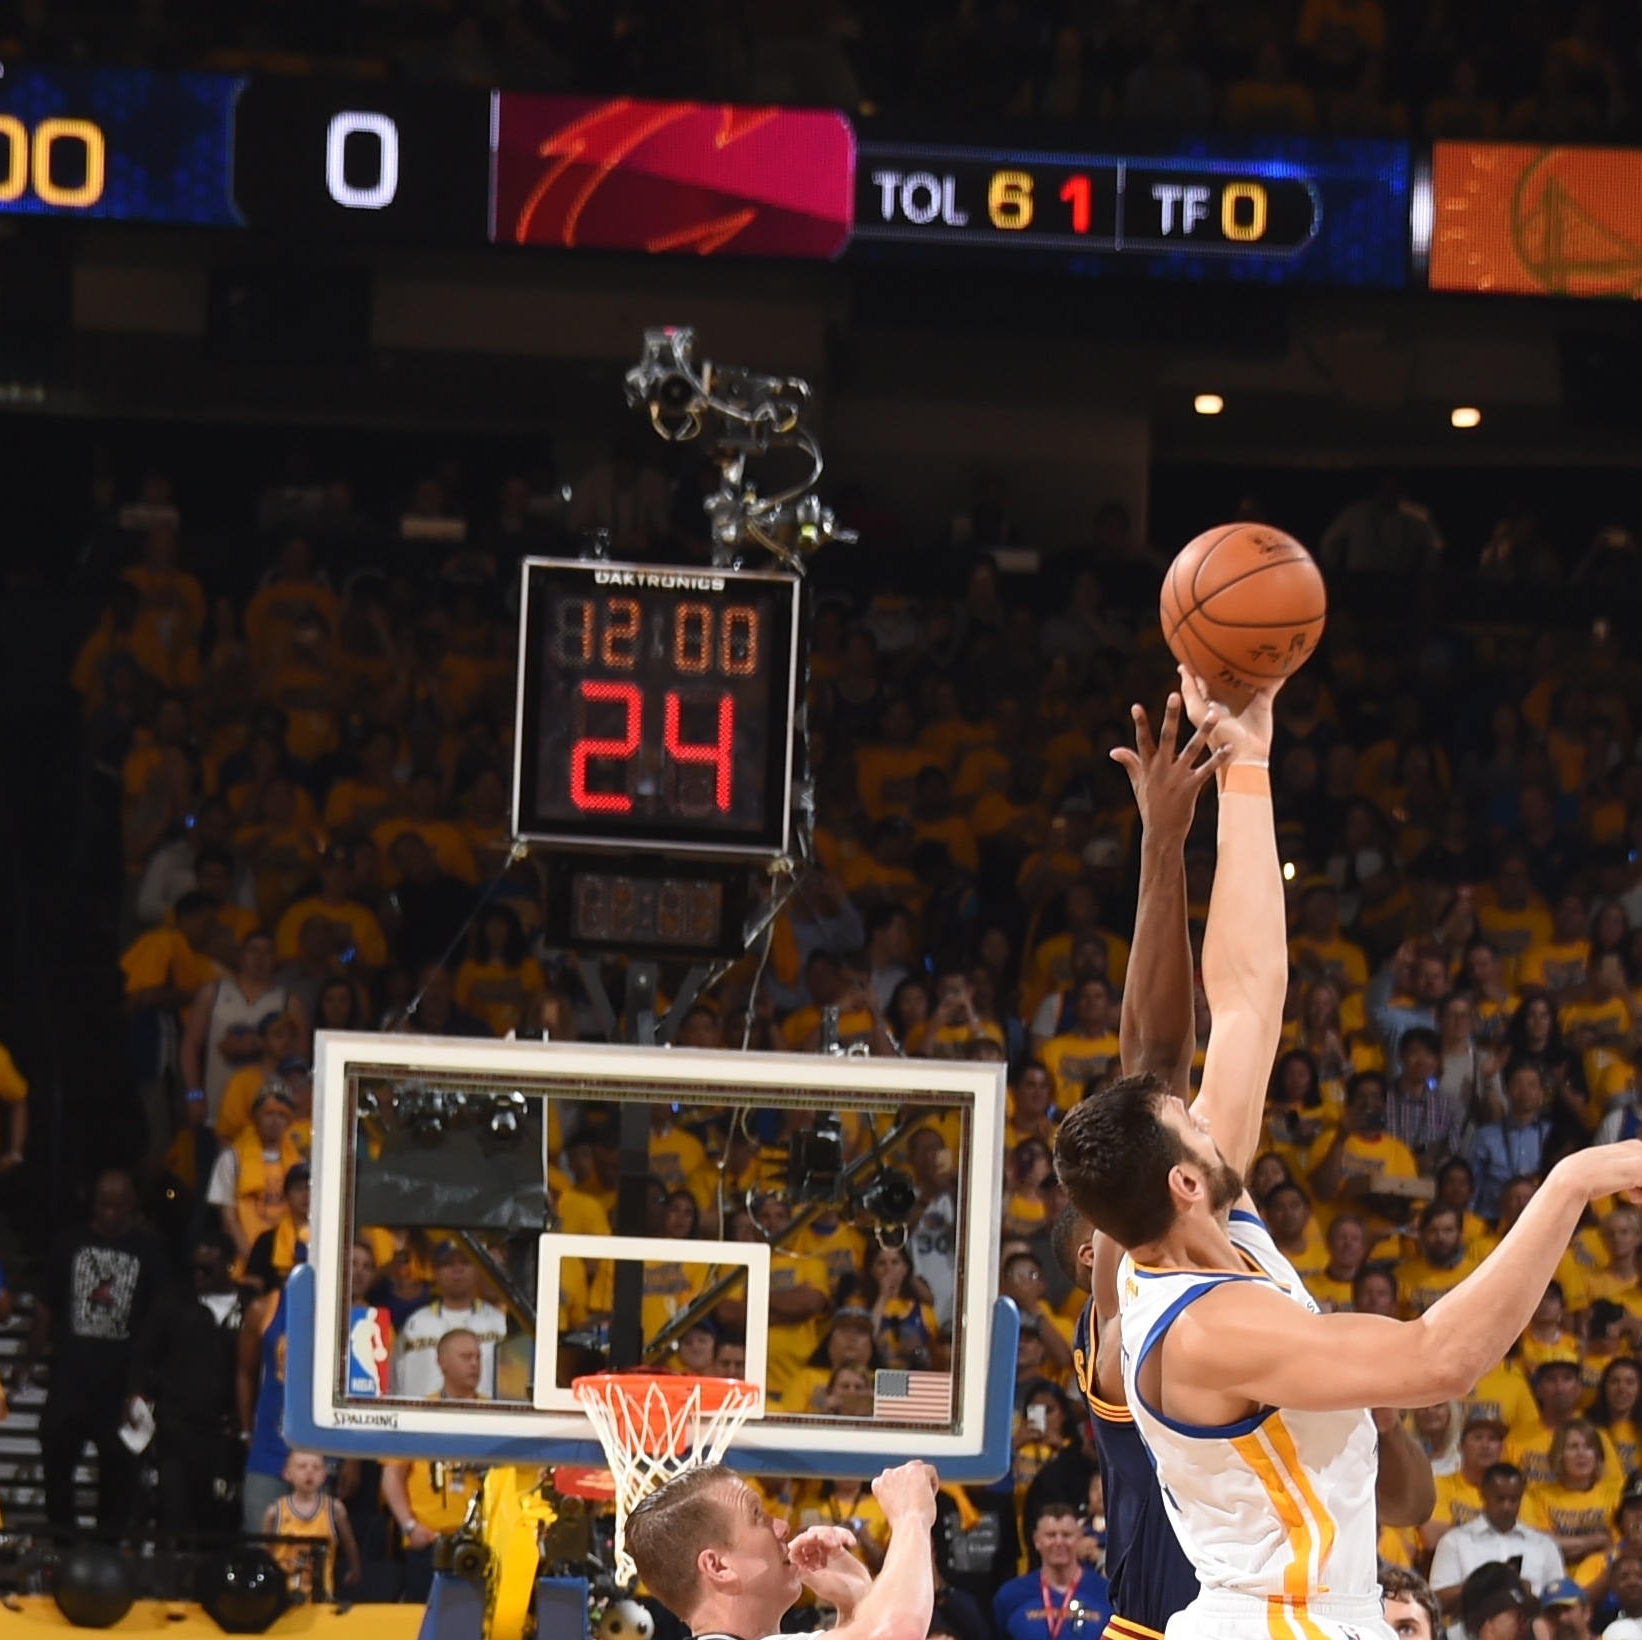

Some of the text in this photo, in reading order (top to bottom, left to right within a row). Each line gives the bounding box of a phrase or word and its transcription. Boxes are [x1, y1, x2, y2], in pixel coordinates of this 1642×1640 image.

[325, 111, 399, 208] 0
[872, 169, 1093, 235] TOL 6 1
[1151, 182, 1267, 243] TF 0
[570, 679, 736, 814] 24
[332, 1411, 399, 1429] SPALDING
